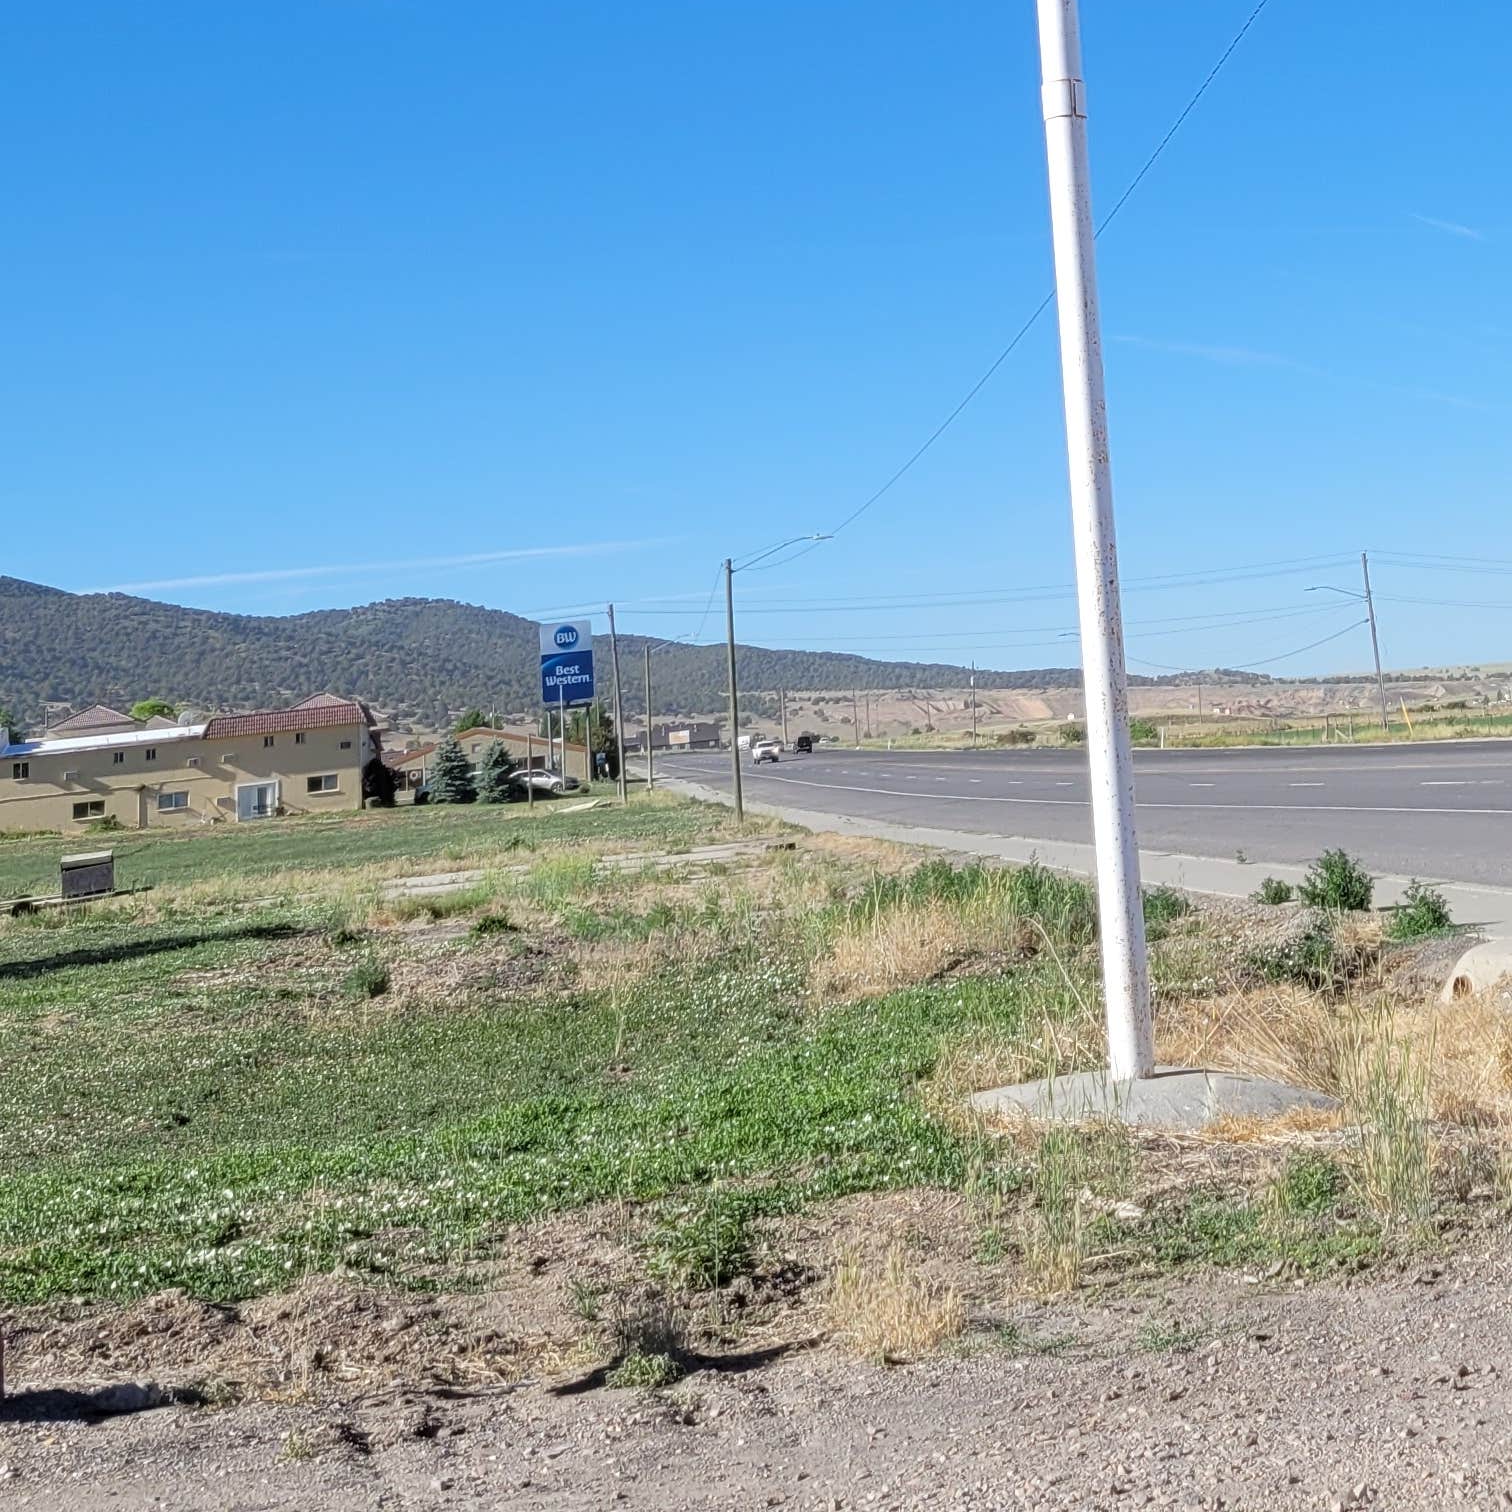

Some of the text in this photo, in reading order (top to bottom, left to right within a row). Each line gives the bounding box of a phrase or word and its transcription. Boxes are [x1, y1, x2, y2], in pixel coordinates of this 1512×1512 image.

[557, 631, 577, 643] BW
[556, 665, 580, 676] Best
[545, 674, 590, 687] Western
